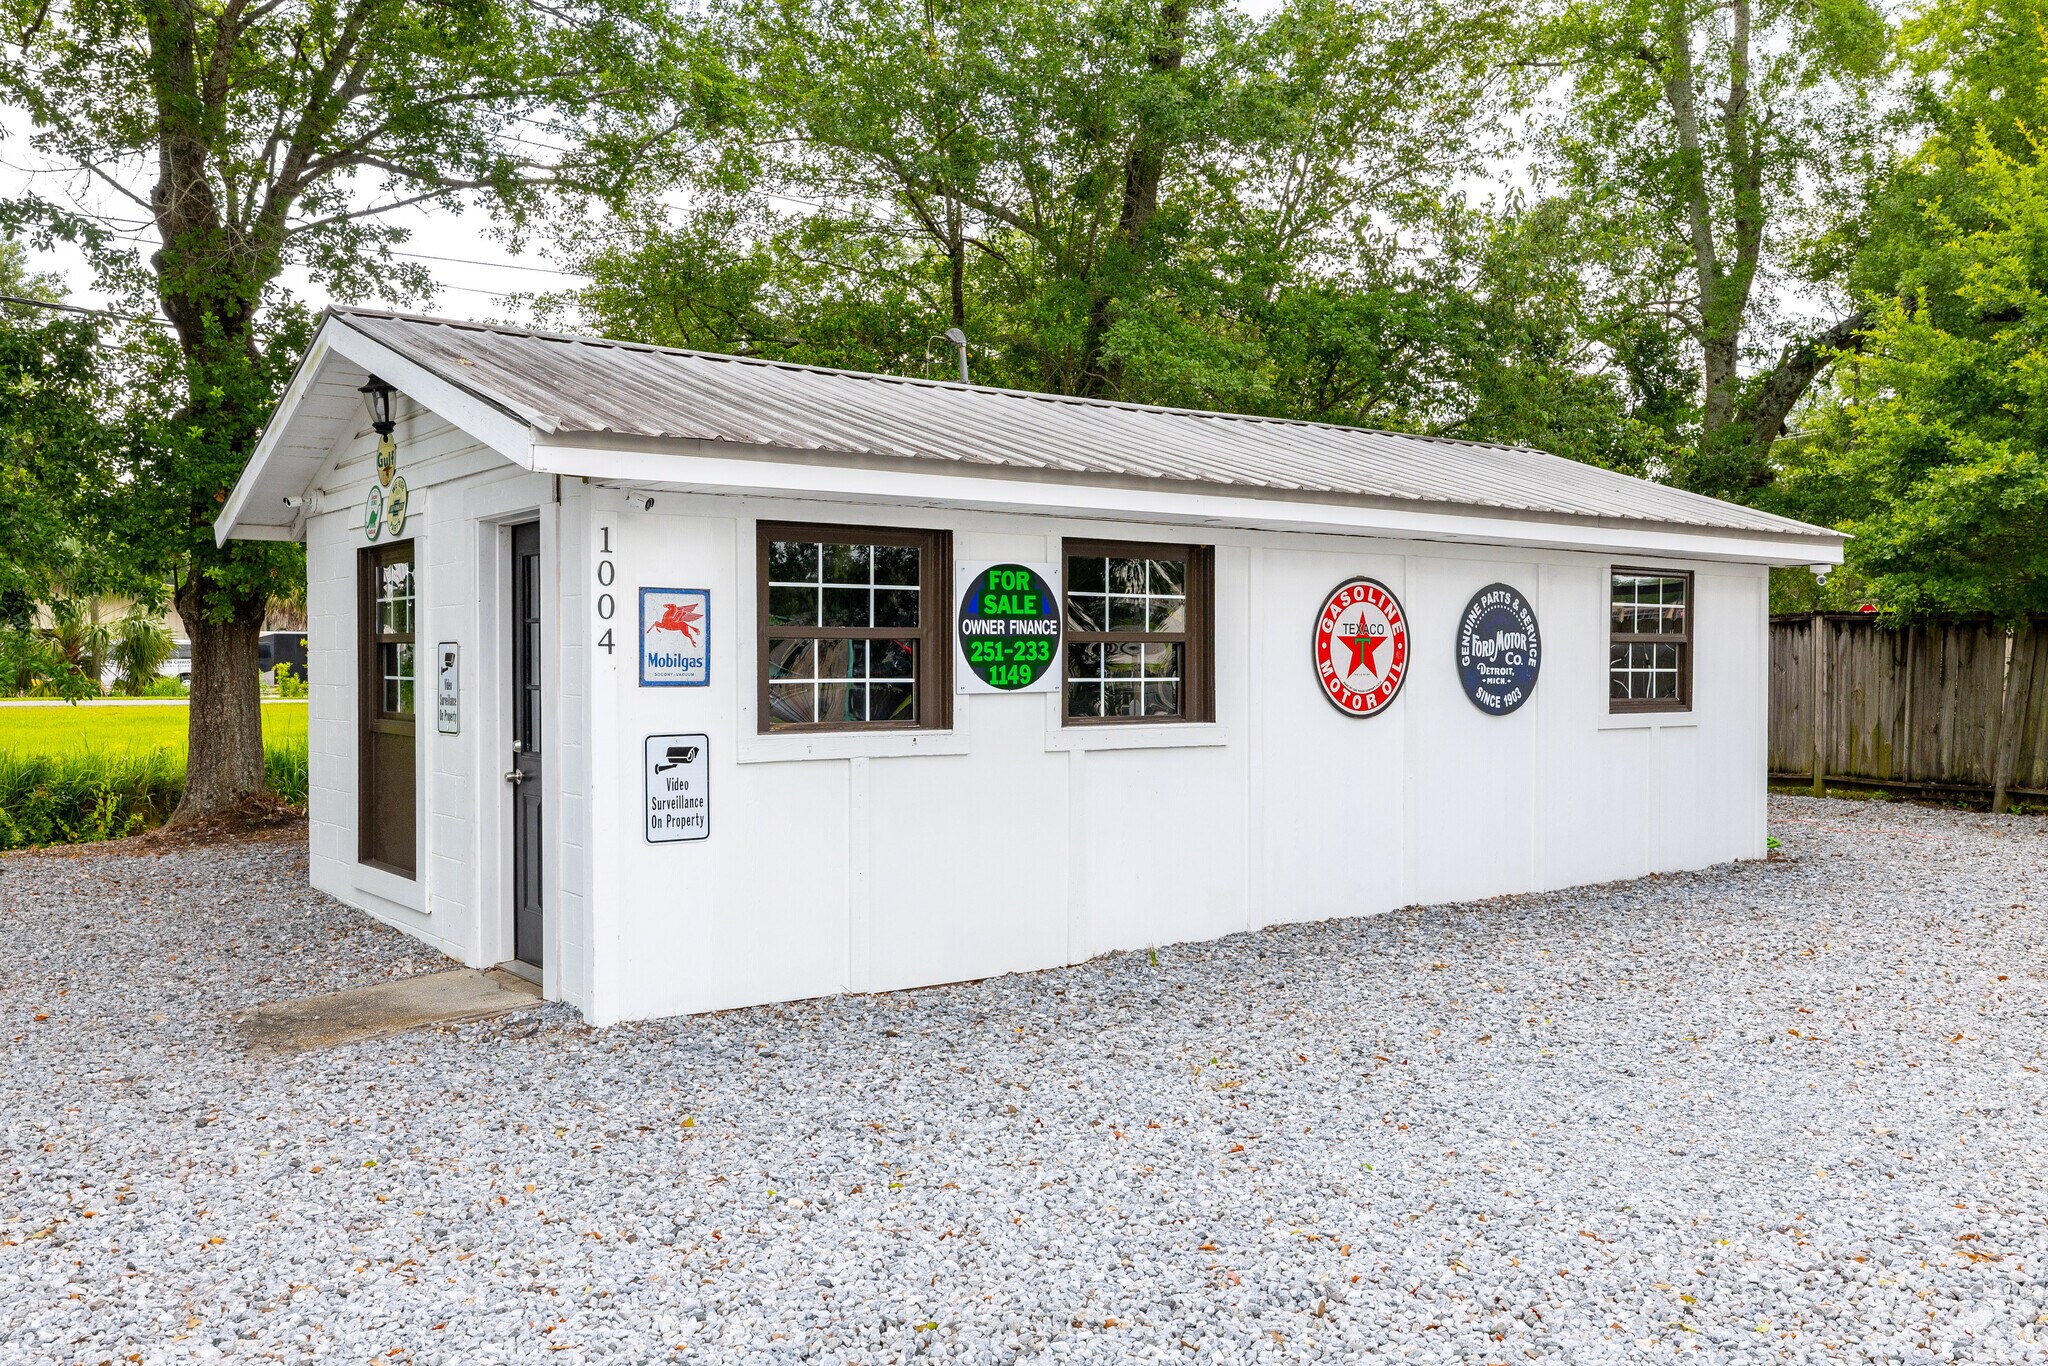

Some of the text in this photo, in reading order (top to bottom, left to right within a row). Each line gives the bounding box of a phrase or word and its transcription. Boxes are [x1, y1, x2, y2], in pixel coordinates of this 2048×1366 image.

[377, 450, 395, 468] Gulf
[597, 526, 616, 655] 1004
[989, 570, 1030, 591] FOR
[984, 594, 1037, 615] SALE
[1321, 585, 1404, 637] GASOLINE
[962, 619, 1058, 635] OWNER FINANCE
[1342, 623, 1385, 636] TEXACO
[1461, 590, 1538, 668] GENUINE PARTS & SERVICE
[970, 641, 1050, 662] 251-233
[1471, 630, 1527, 661] FORD MOTOR
[648, 652, 703, 672] Mobilgas
[989, 664, 1032, 685] 1149
[1320, 658, 1403, 710] MOTOR OIL
[1475, 686, 1522, 709] SINCE 1903
[666, 777, 689, 791] Video
[651, 795, 704, 811] Surveillance
[651, 812, 705, 830] On Property
